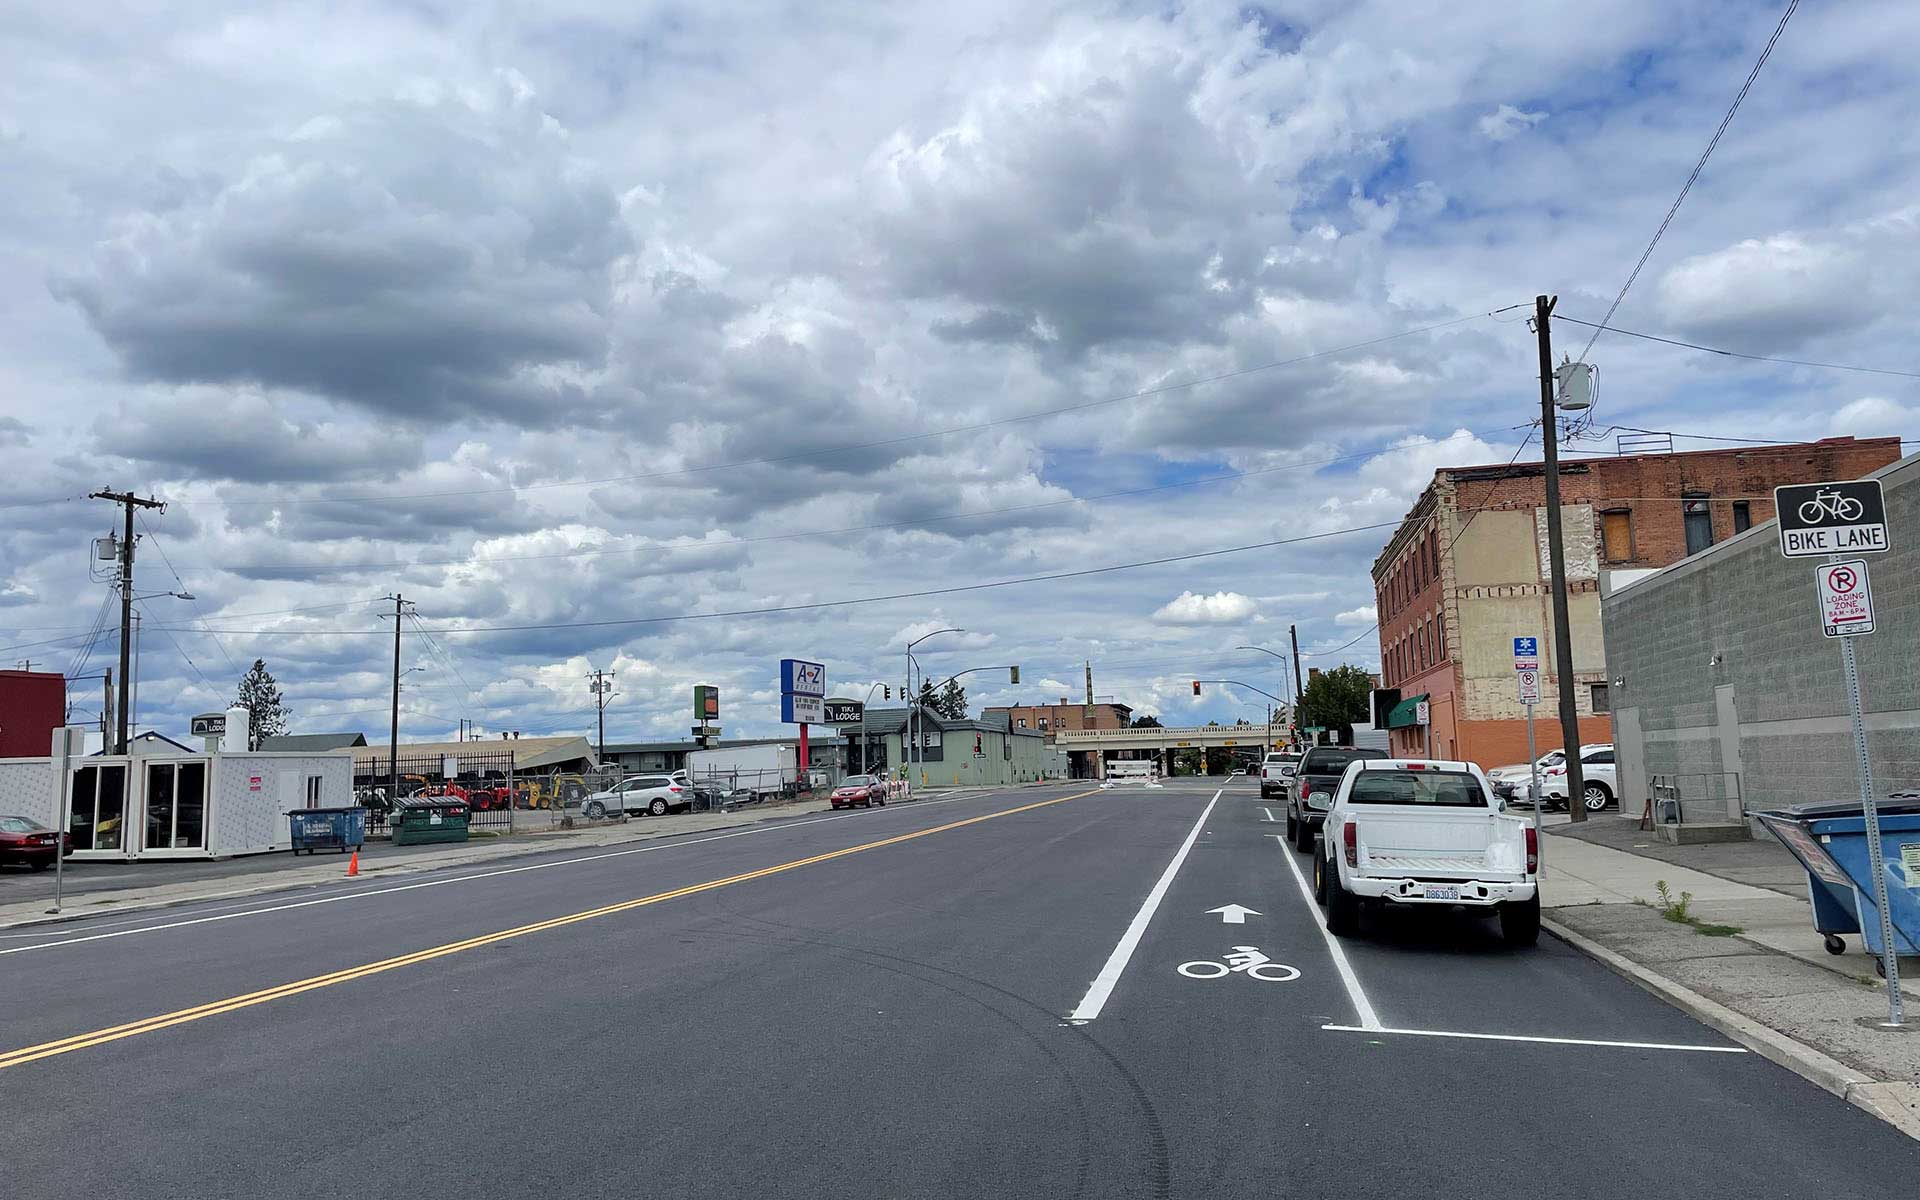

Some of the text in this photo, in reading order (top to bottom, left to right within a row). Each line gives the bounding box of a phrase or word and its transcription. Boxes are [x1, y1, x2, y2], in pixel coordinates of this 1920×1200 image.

[1788, 527, 1883, 550] BIKE LANE
[1826, 592, 1865, 604] LOADING
[1834, 600, 1858, 610] ZONE
[1827, 626, 1836, 636] 10
[835, 712, 861, 721] LODGE
